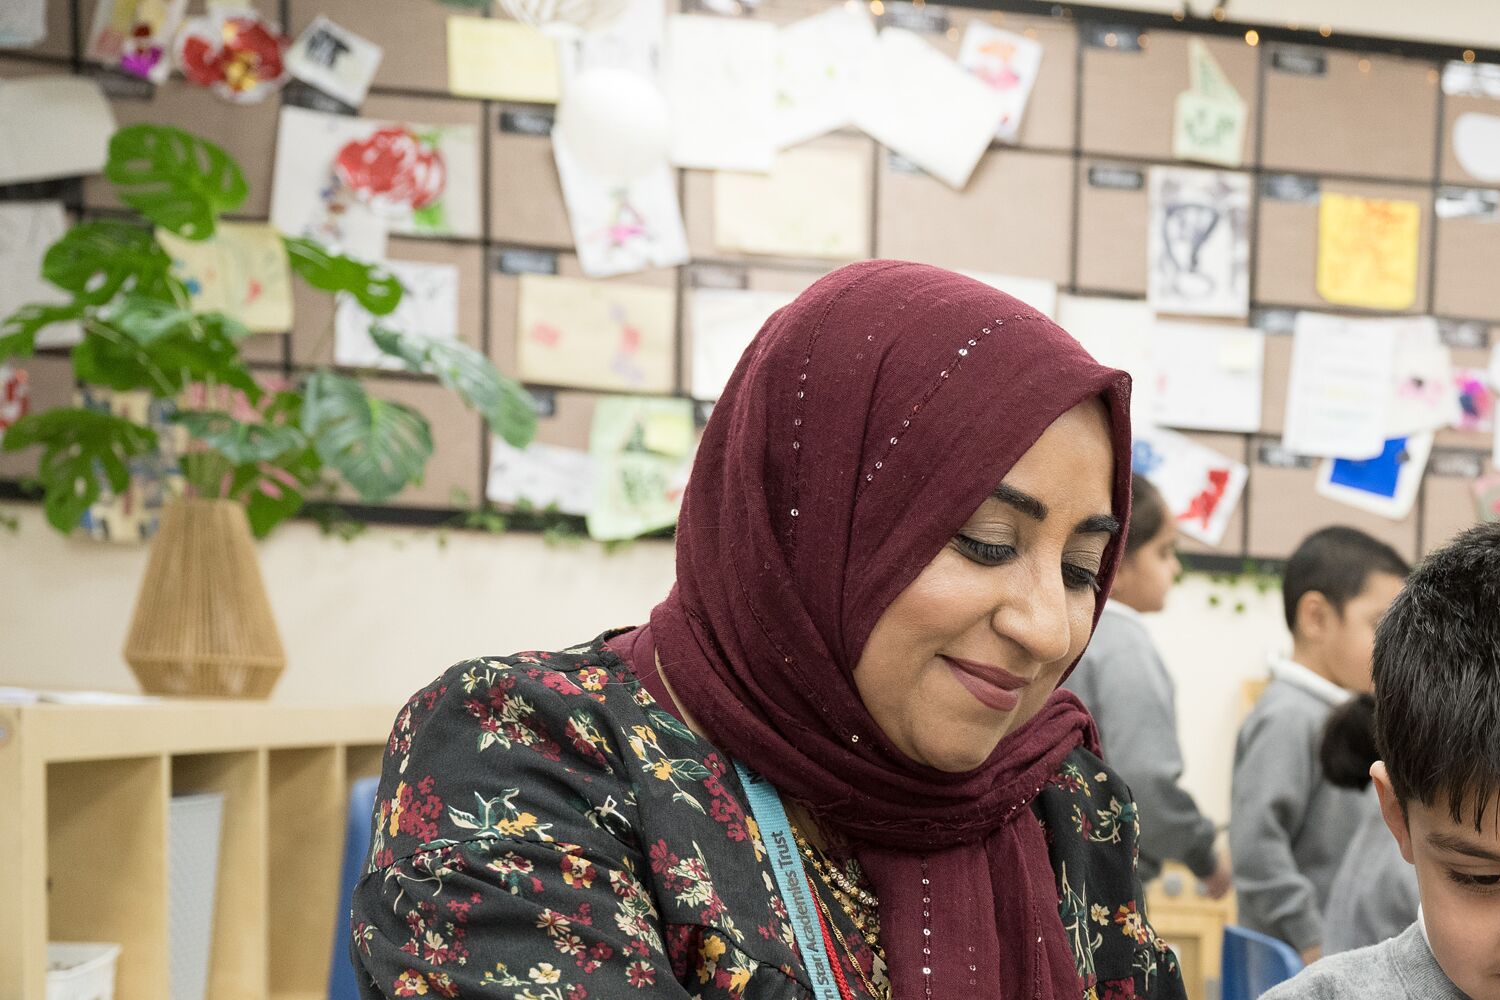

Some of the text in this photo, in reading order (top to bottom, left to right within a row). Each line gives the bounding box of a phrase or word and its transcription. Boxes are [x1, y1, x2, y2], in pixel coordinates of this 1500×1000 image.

[771, 829, 794, 870] Trust
[785, 870, 819, 953] Academies
[812, 954, 829, 986] Star
